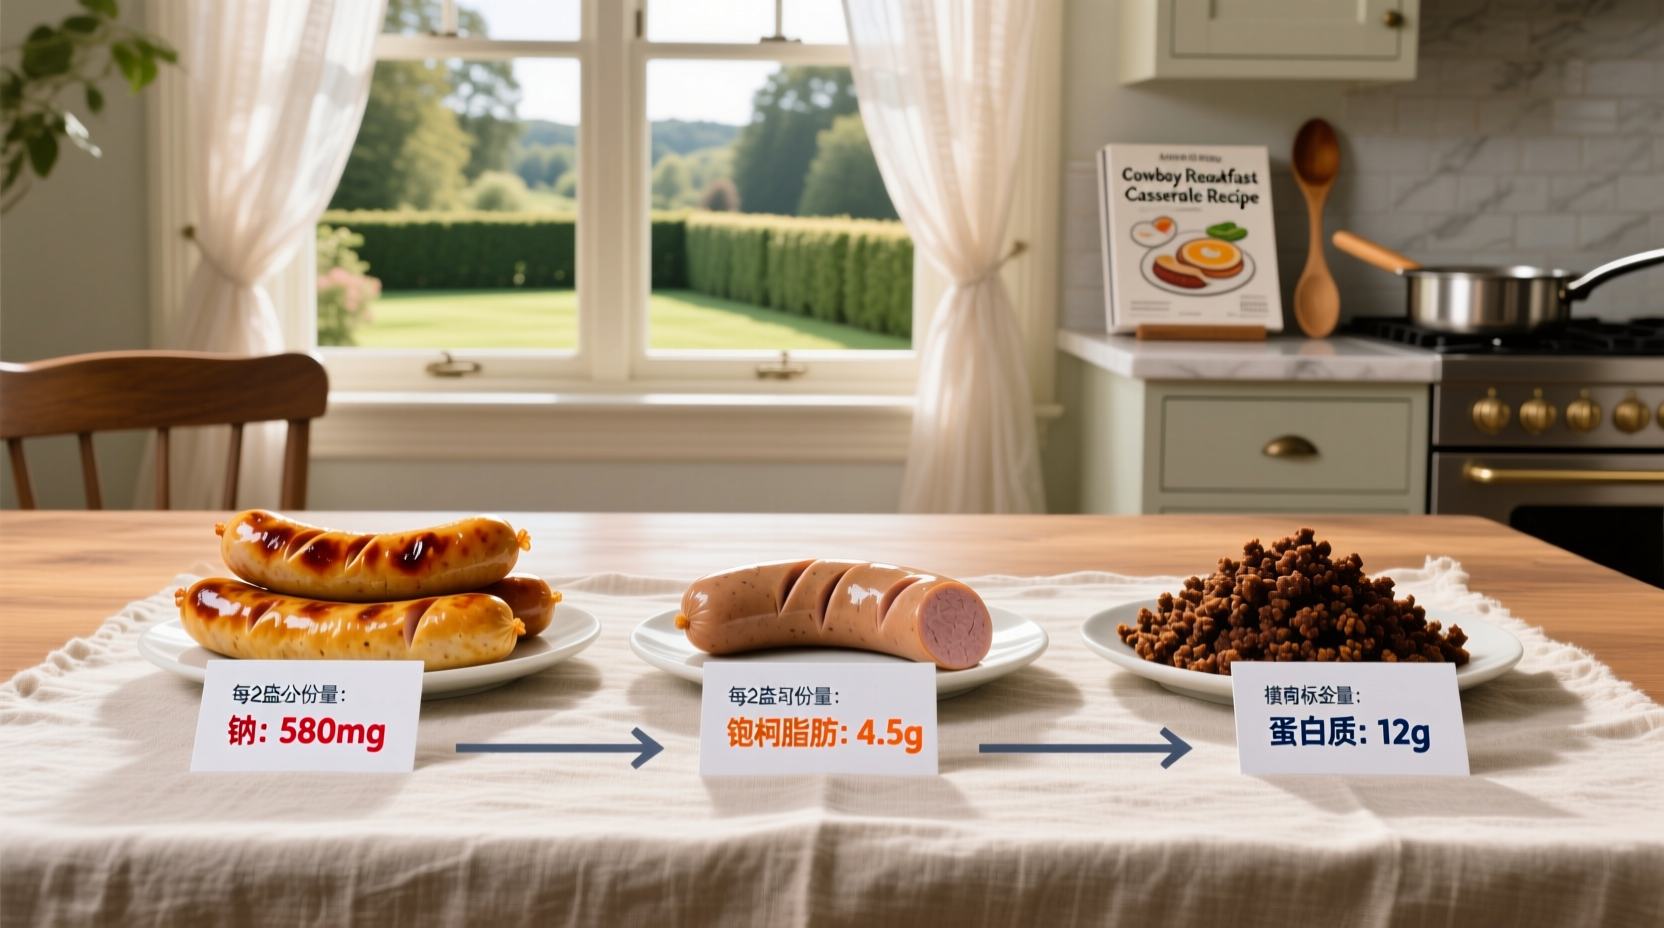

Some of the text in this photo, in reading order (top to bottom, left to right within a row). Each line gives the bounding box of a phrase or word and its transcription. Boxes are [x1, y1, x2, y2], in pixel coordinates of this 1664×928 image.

[1122, 167, 1182, 188] Cowboy
[1206, 188, 1260, 210] Recipe
[278, 716, 386, 753] 580mg
[856, 718, 923, 754] 4.5g
[1269, 715, 1431, 754] 蛋白质: 12g
